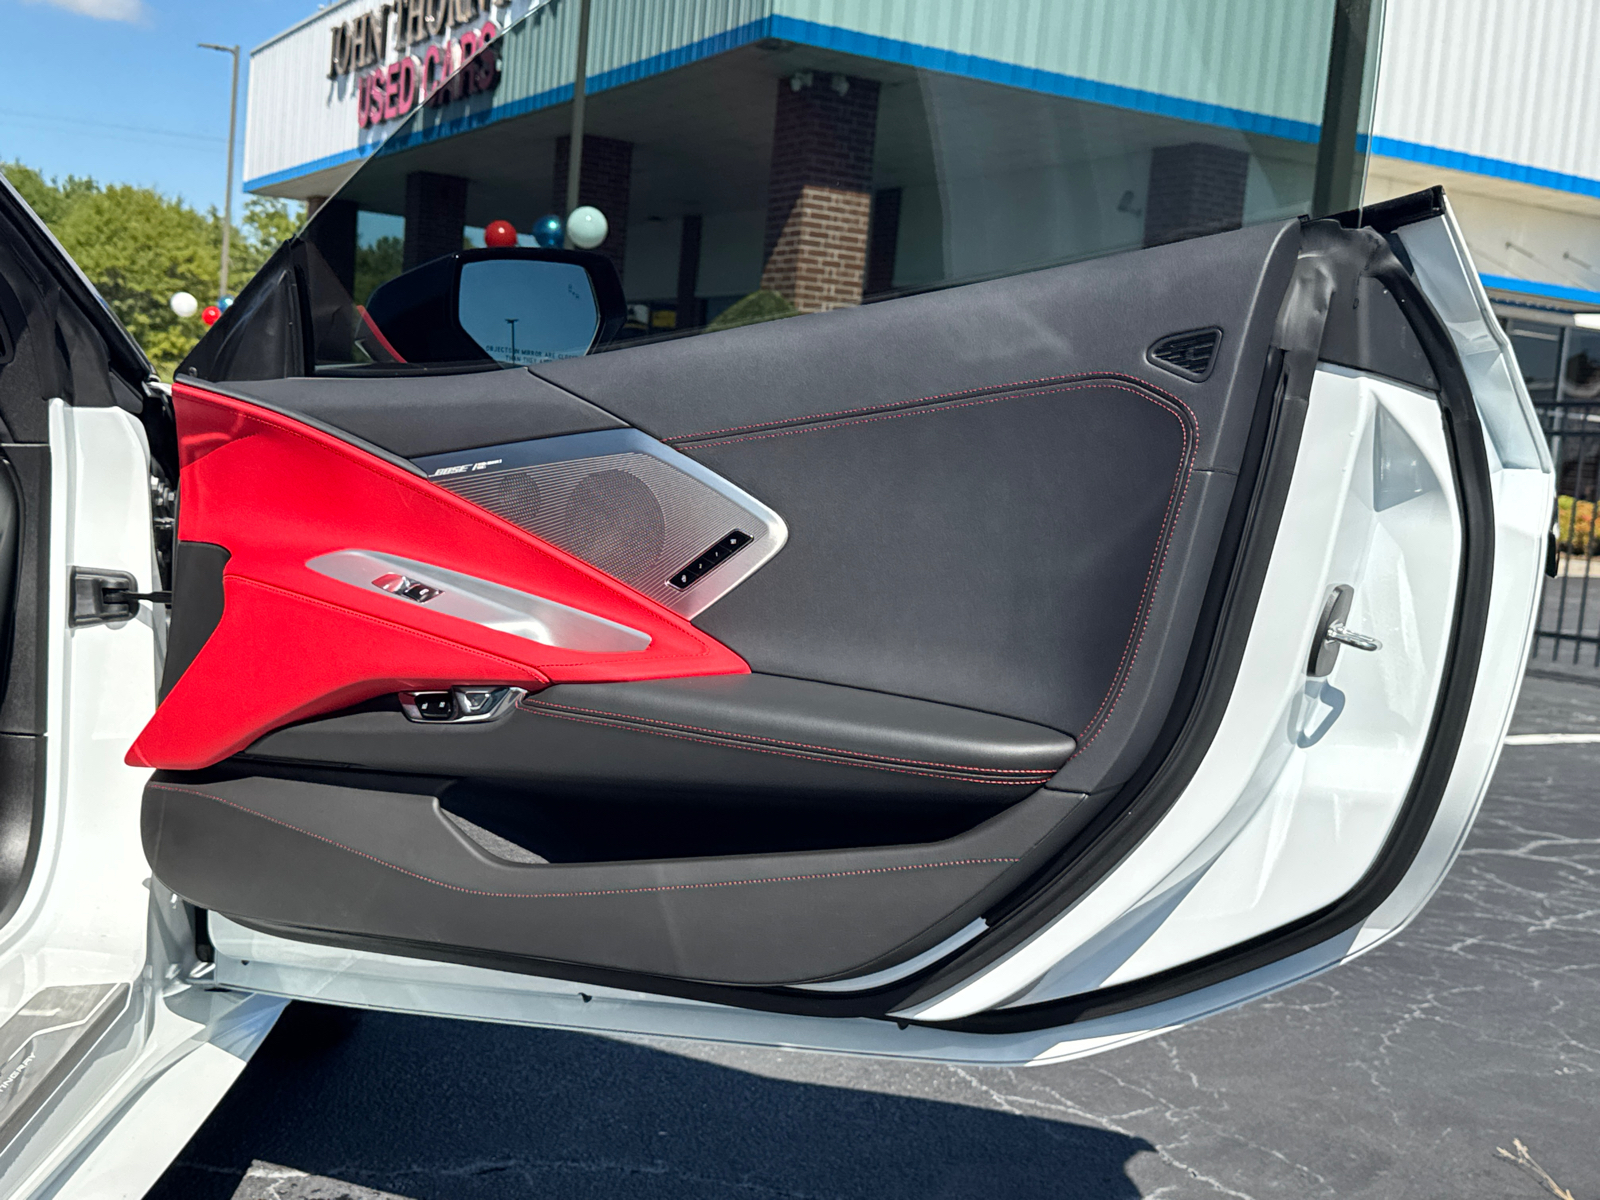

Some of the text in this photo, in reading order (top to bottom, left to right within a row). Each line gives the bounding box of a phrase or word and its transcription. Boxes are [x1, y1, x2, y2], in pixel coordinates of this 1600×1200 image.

[327, 4, 388, 79] JOHN
[358, 21, 498, 129] USED CARS
